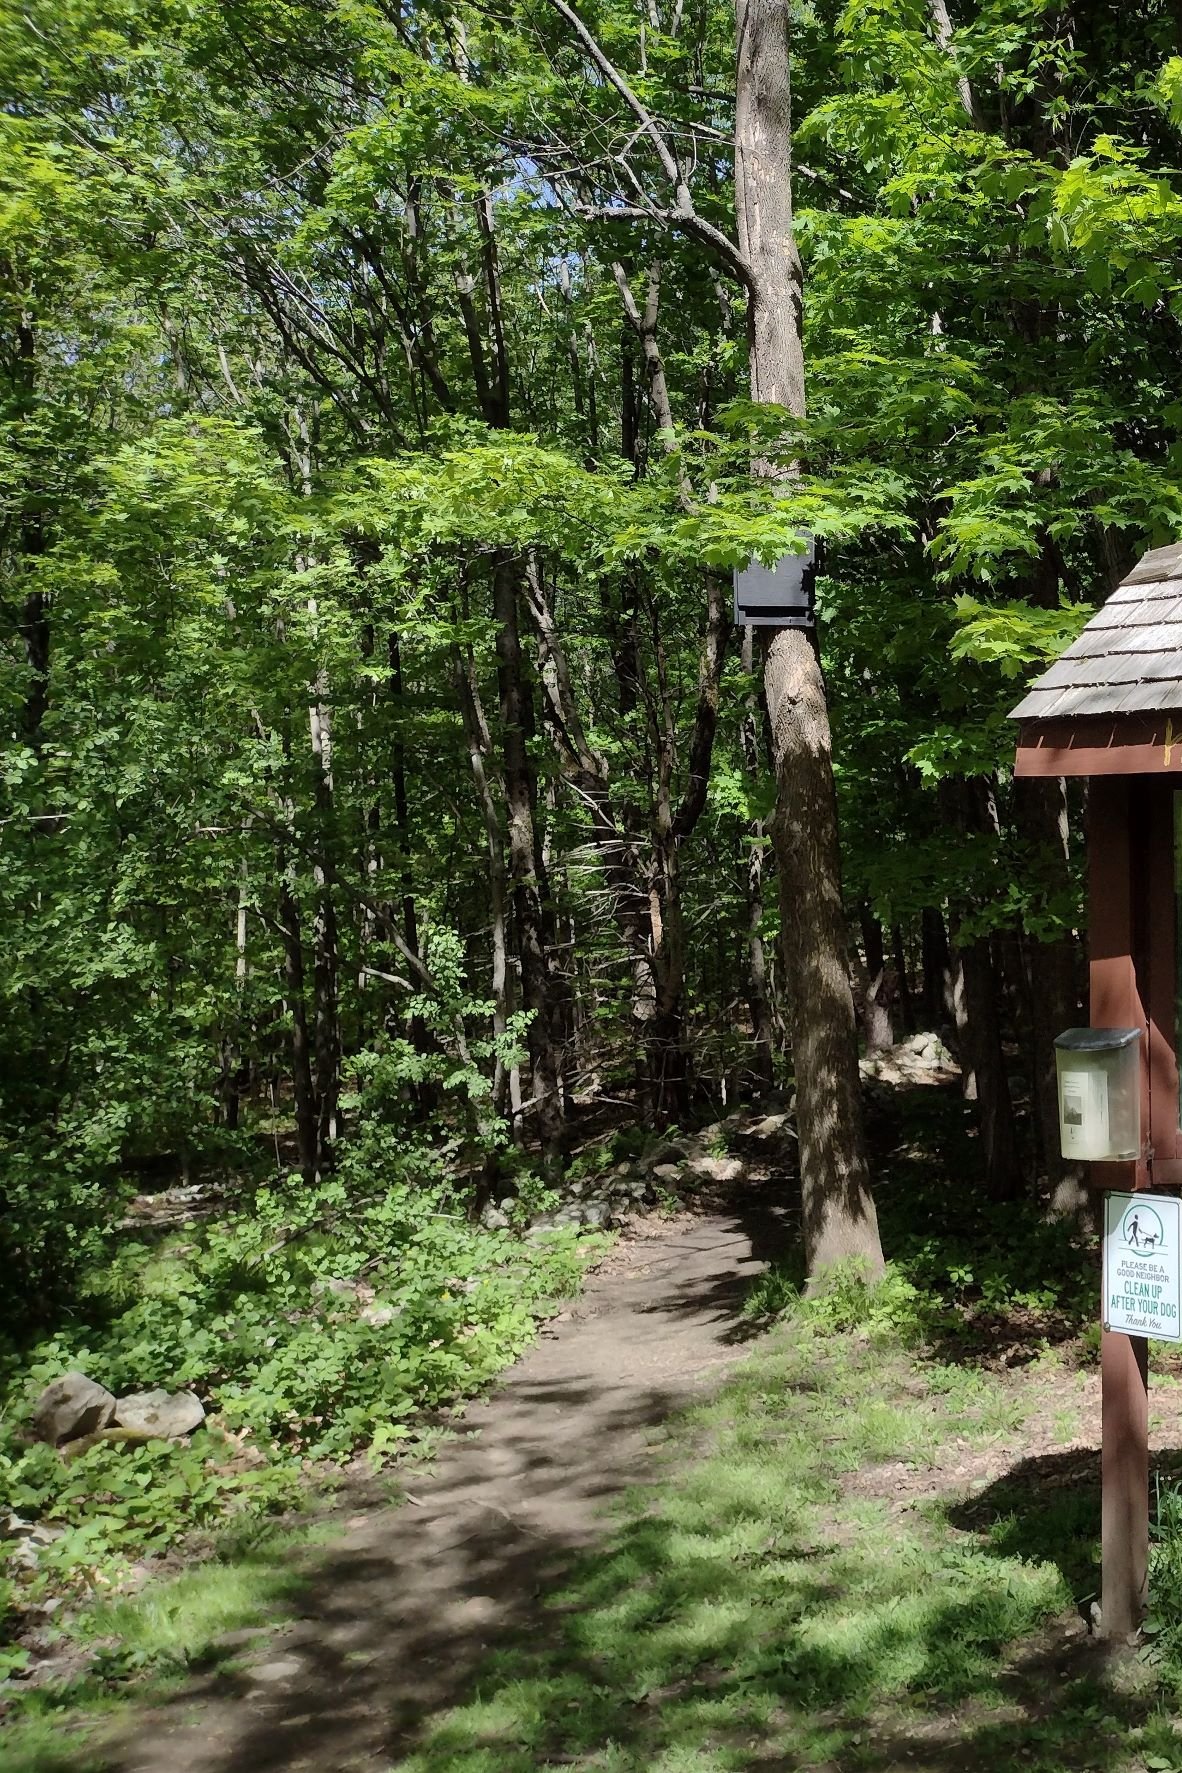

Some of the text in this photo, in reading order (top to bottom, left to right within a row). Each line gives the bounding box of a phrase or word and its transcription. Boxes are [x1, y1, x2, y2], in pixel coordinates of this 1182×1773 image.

[1117, 1268, 1170, 1283] GOOD NEIGHBOR
[1121, 1260, 1165, 1274] PLEASE BE A
[1124, 1280, 1163, 1299] CLEAN UP
[1111, 1294, 1177, 1319] AFTER YOUR DOG
[1125, 1313, 1163, 1330] Thank You
